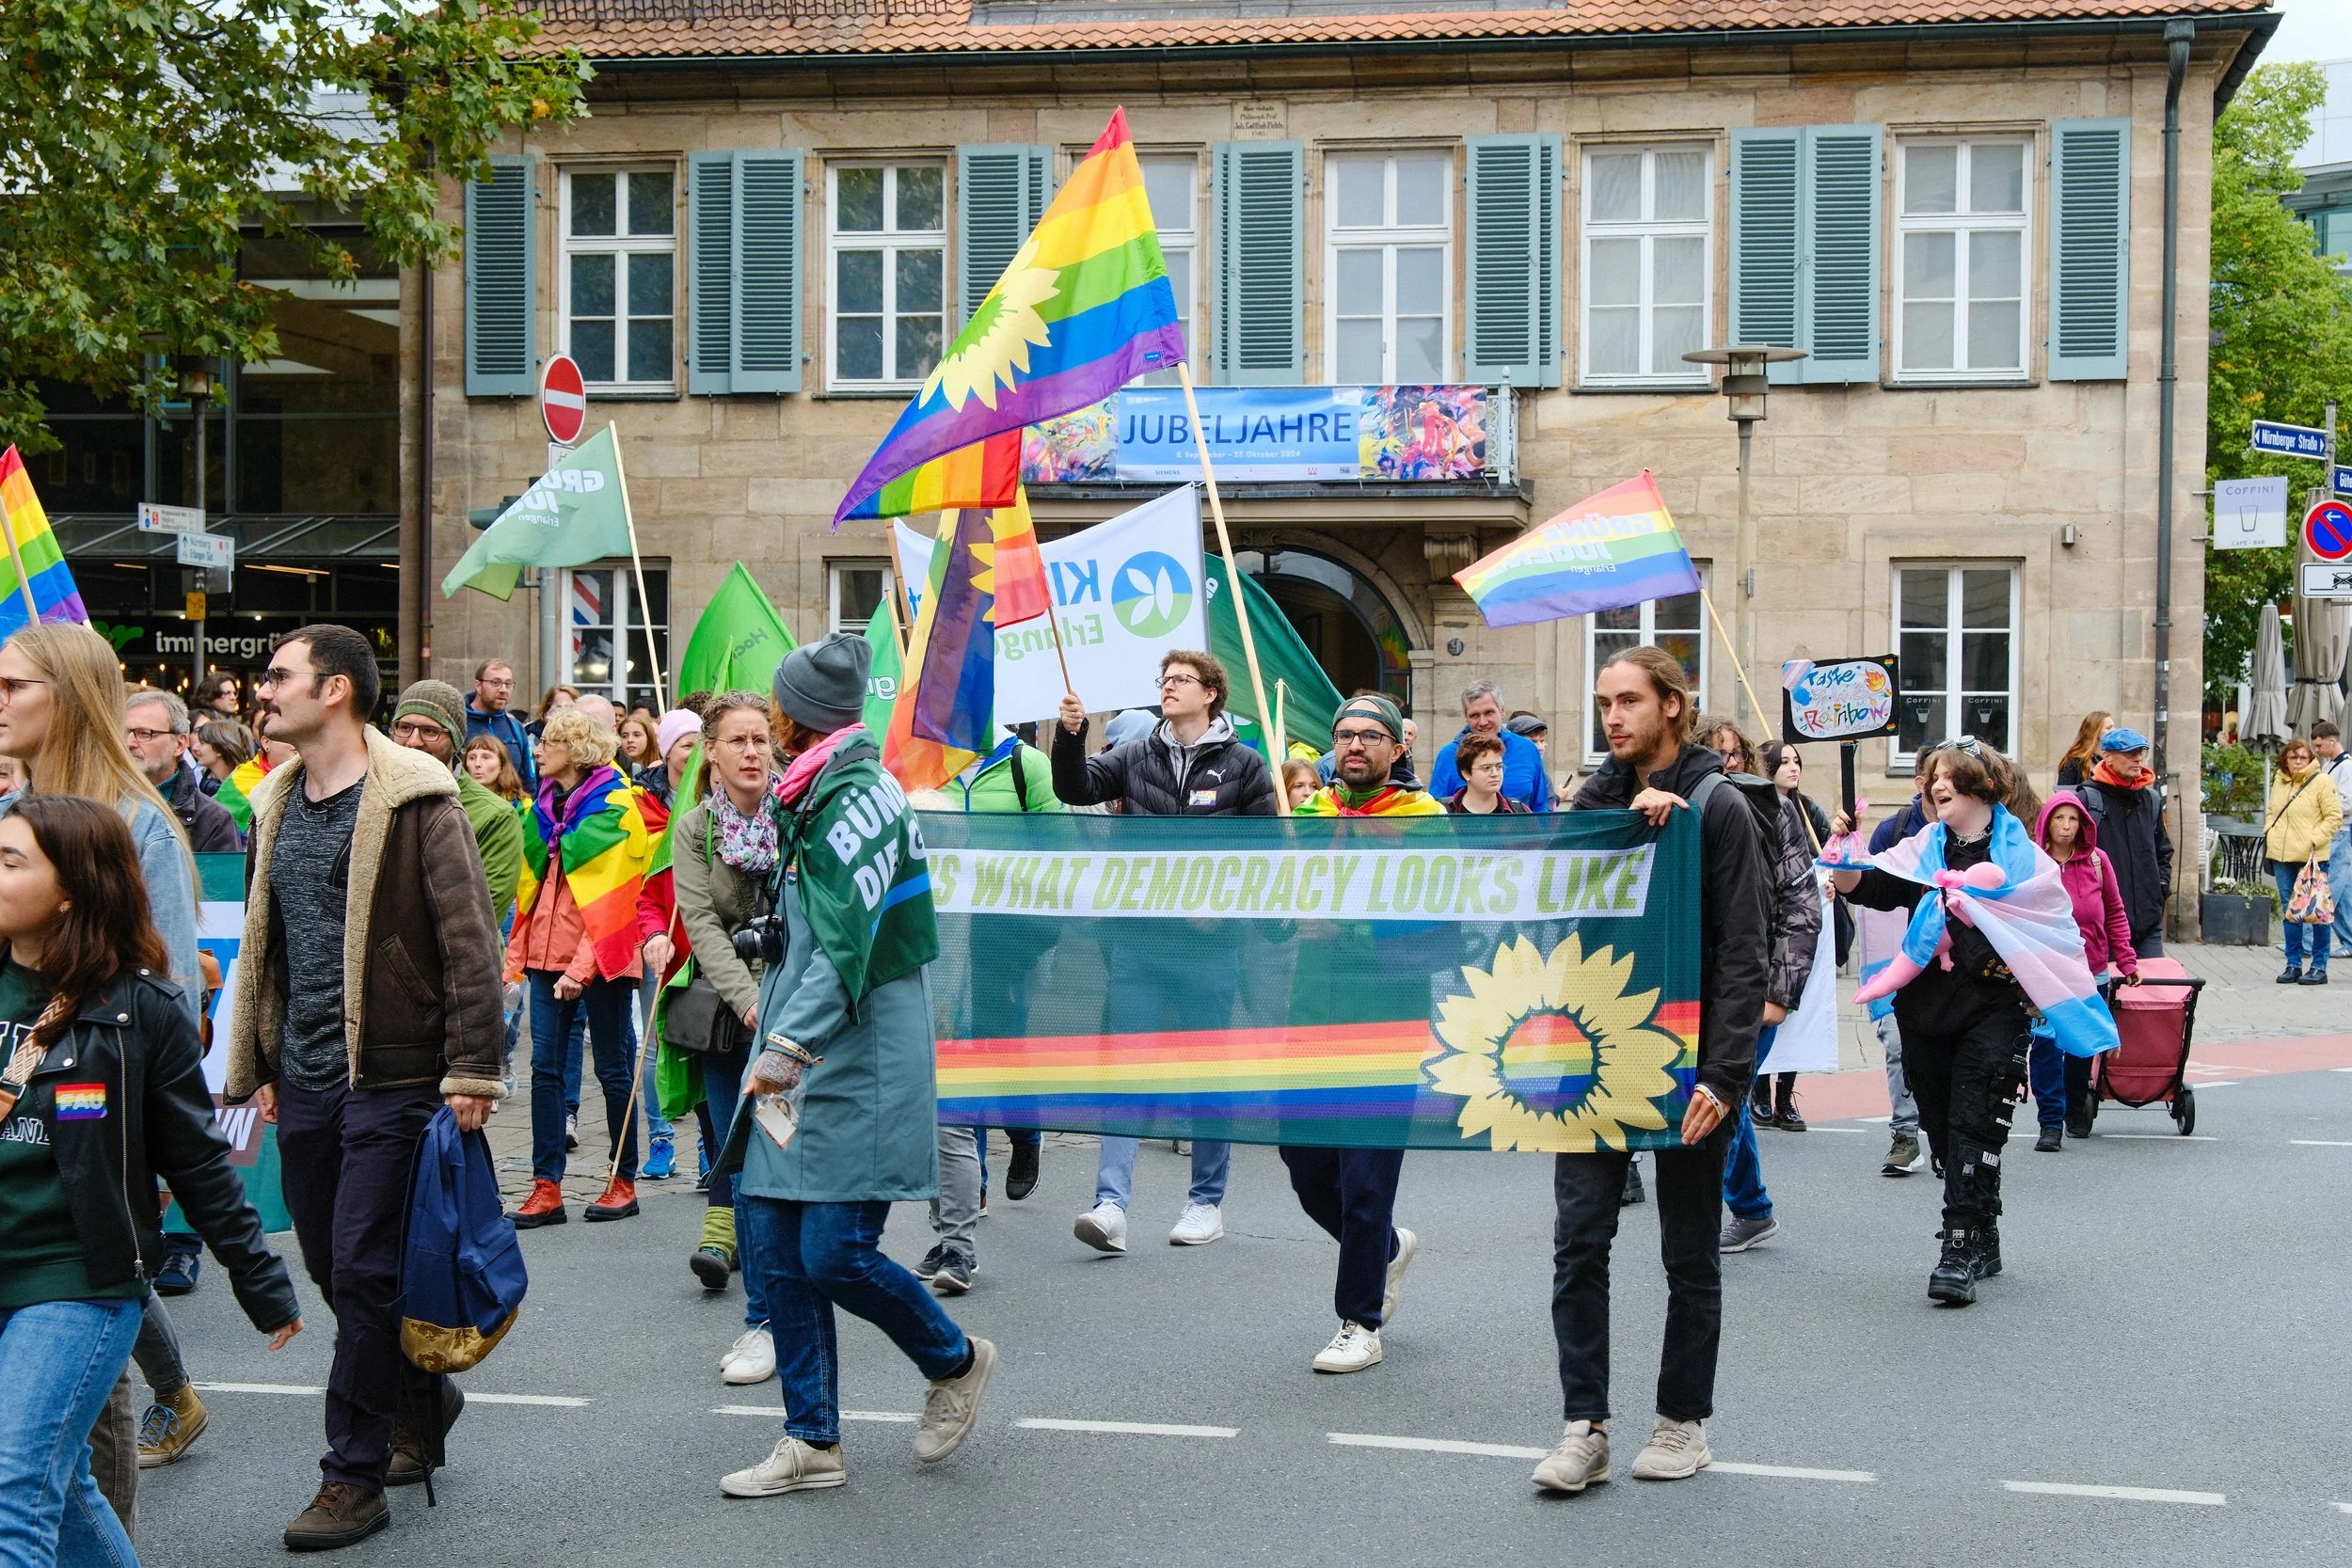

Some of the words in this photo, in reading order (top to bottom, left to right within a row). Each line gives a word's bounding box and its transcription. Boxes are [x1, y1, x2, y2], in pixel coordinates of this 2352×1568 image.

[1123, 413, 1351, 444] JUBELJAHRE
[2262, 429, 2296, 451] Nürnberger
[2298, 434, 2318, 451] Straße
[1805, 666, 1856, 689] Taste
[971, 854, 1091, 910] WHAT
[1092, 854, 1361, 911] DEMOCRACY
[1366, 854, 1524, 914] LOOKS
[1535, 849, 1646, 914] LIKE
[59, 1092, 103, 1112] FAU
